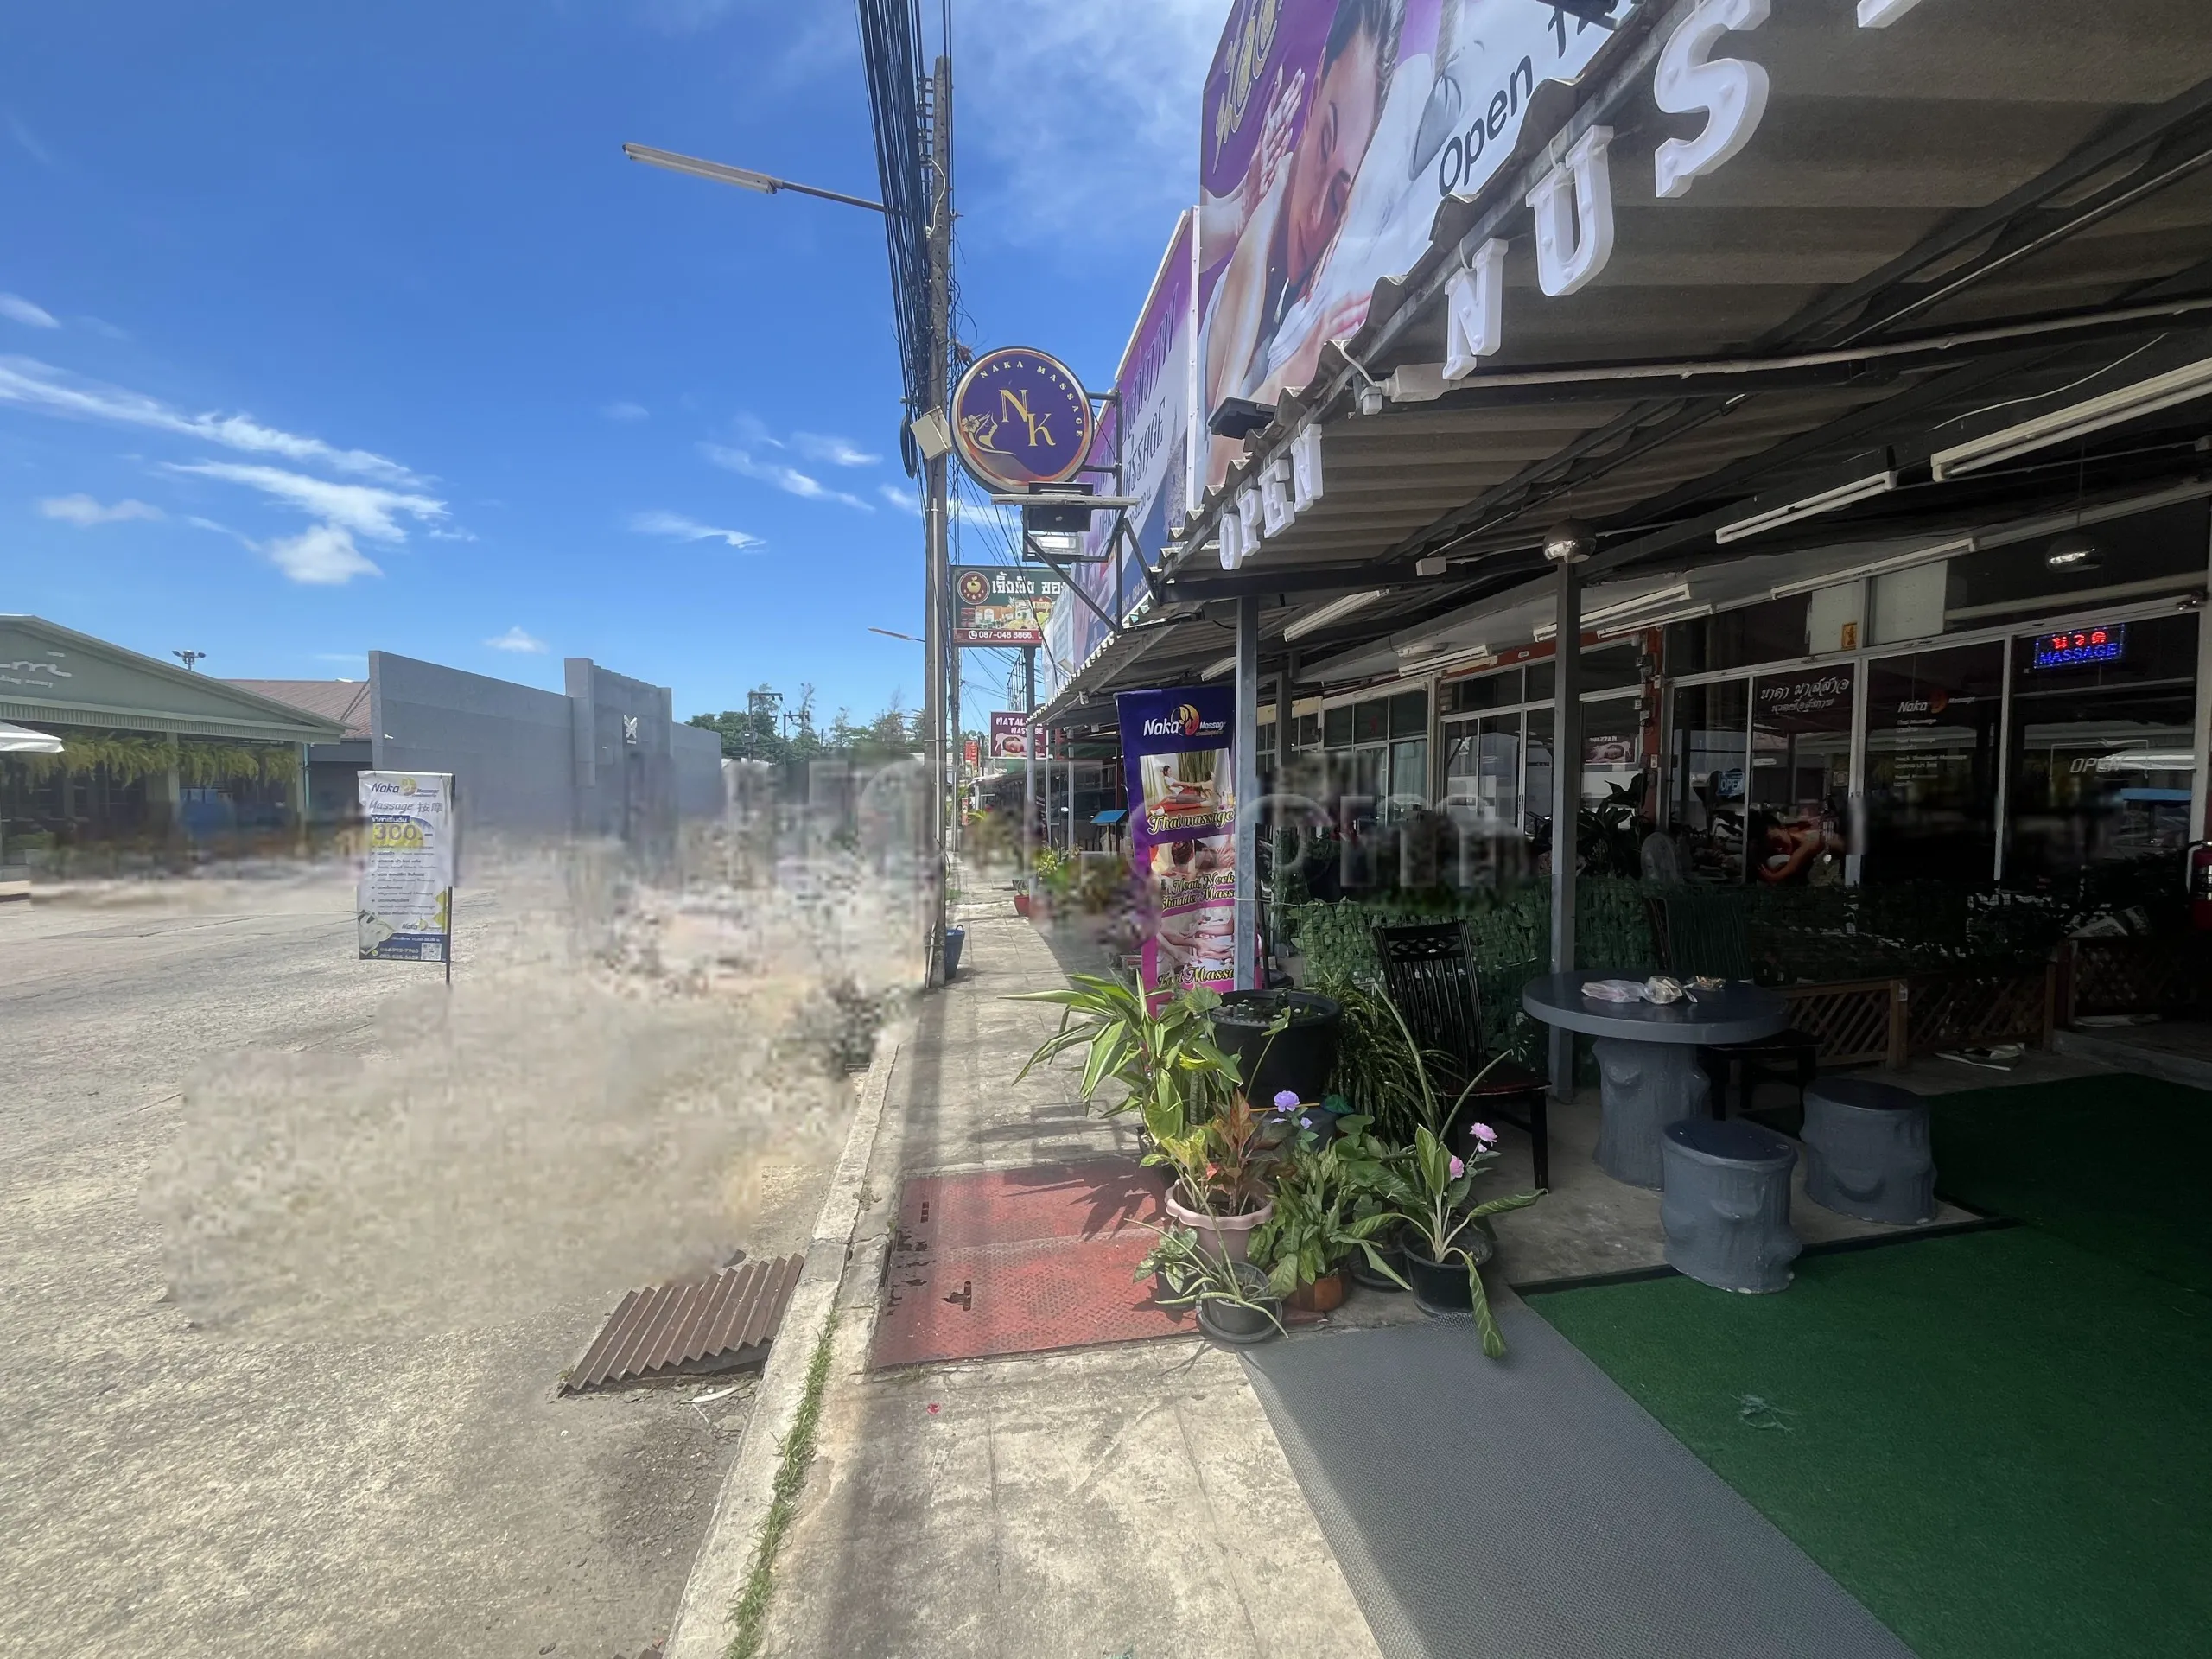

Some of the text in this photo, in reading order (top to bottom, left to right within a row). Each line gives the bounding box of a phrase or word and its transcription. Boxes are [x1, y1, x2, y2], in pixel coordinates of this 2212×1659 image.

[1439, 55, 1533, 197] Open
[980, 360, 1084, 437] NAKA MASSAGE
[1219, 423, 1324, 570] OPEN
[2039, 643, 2118, 664] MASSAGE
[1897, 700, 1928, 713] Naka
[1143, 718, 1179, 736] Naka
[2070, 756, 2125, 773] OPEN
[371, 783, 400, 794] Naka
[369, 800, 414, 814] Massage
[1147, 810, 1235, 835] Thai massage
[1198, 887, 1235, 902] Mass
[1184, 966, 1235, 984] Massa
